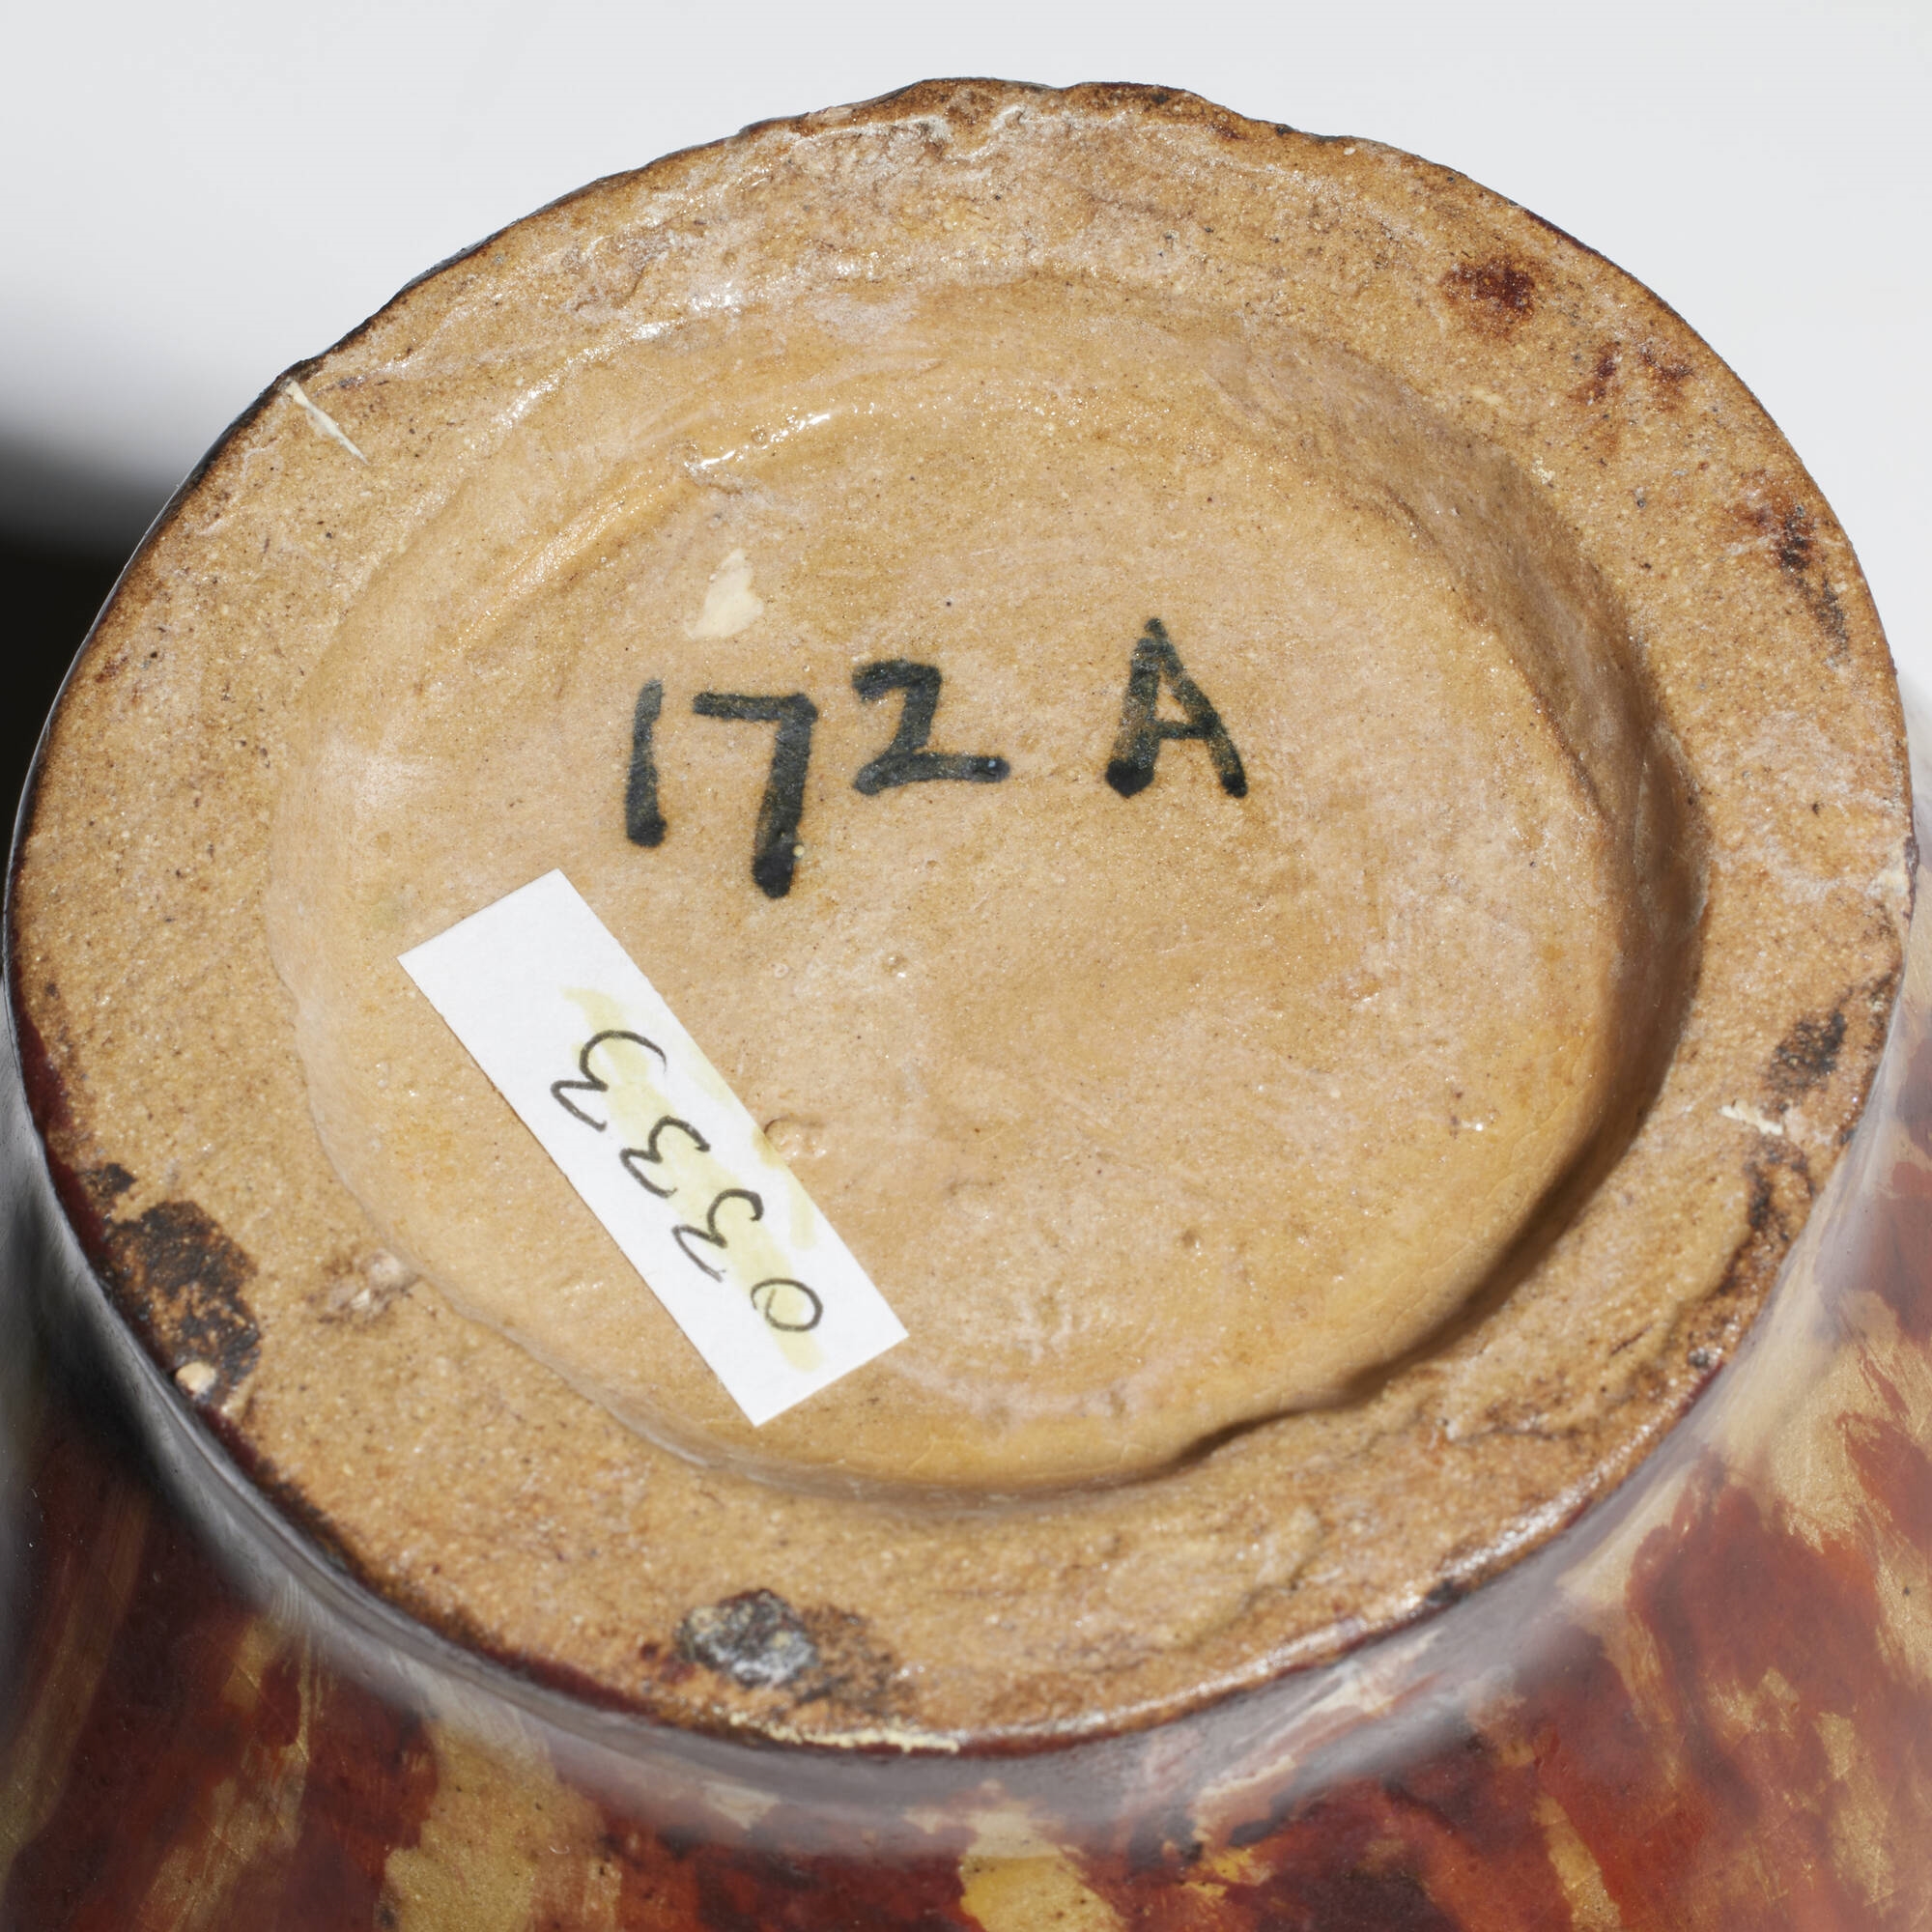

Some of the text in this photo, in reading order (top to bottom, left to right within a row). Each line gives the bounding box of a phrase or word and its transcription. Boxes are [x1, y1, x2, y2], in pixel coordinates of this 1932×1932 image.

[625, 617, 1249, 899] 172 A
[550, 1029, 824, 1333] 0333
